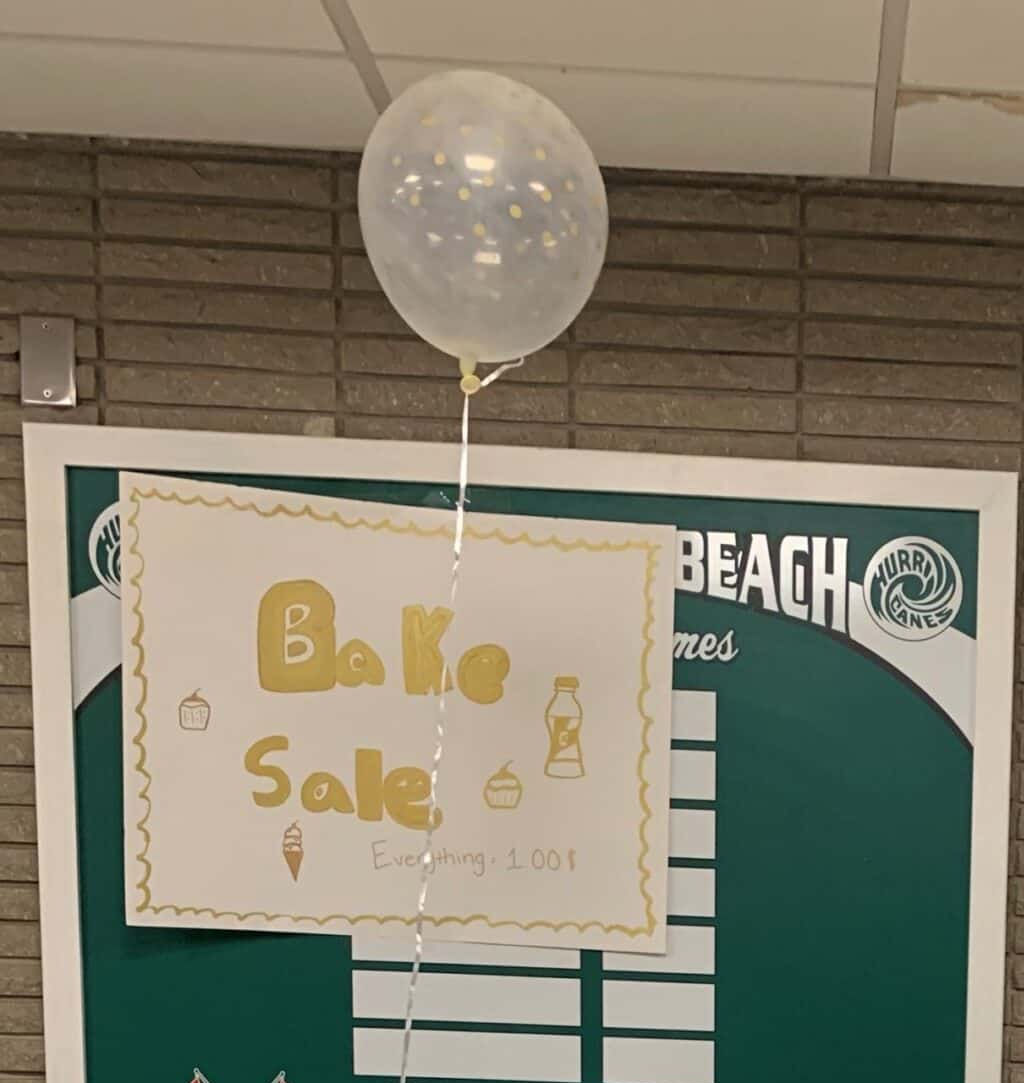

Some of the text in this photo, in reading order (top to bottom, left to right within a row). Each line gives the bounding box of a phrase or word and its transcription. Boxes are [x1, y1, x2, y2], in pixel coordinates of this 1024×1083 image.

[676, 529, 848, 634] BEACH
[890, 594, 953, 629] CANES
[244, 735, 443, 830] Sale
